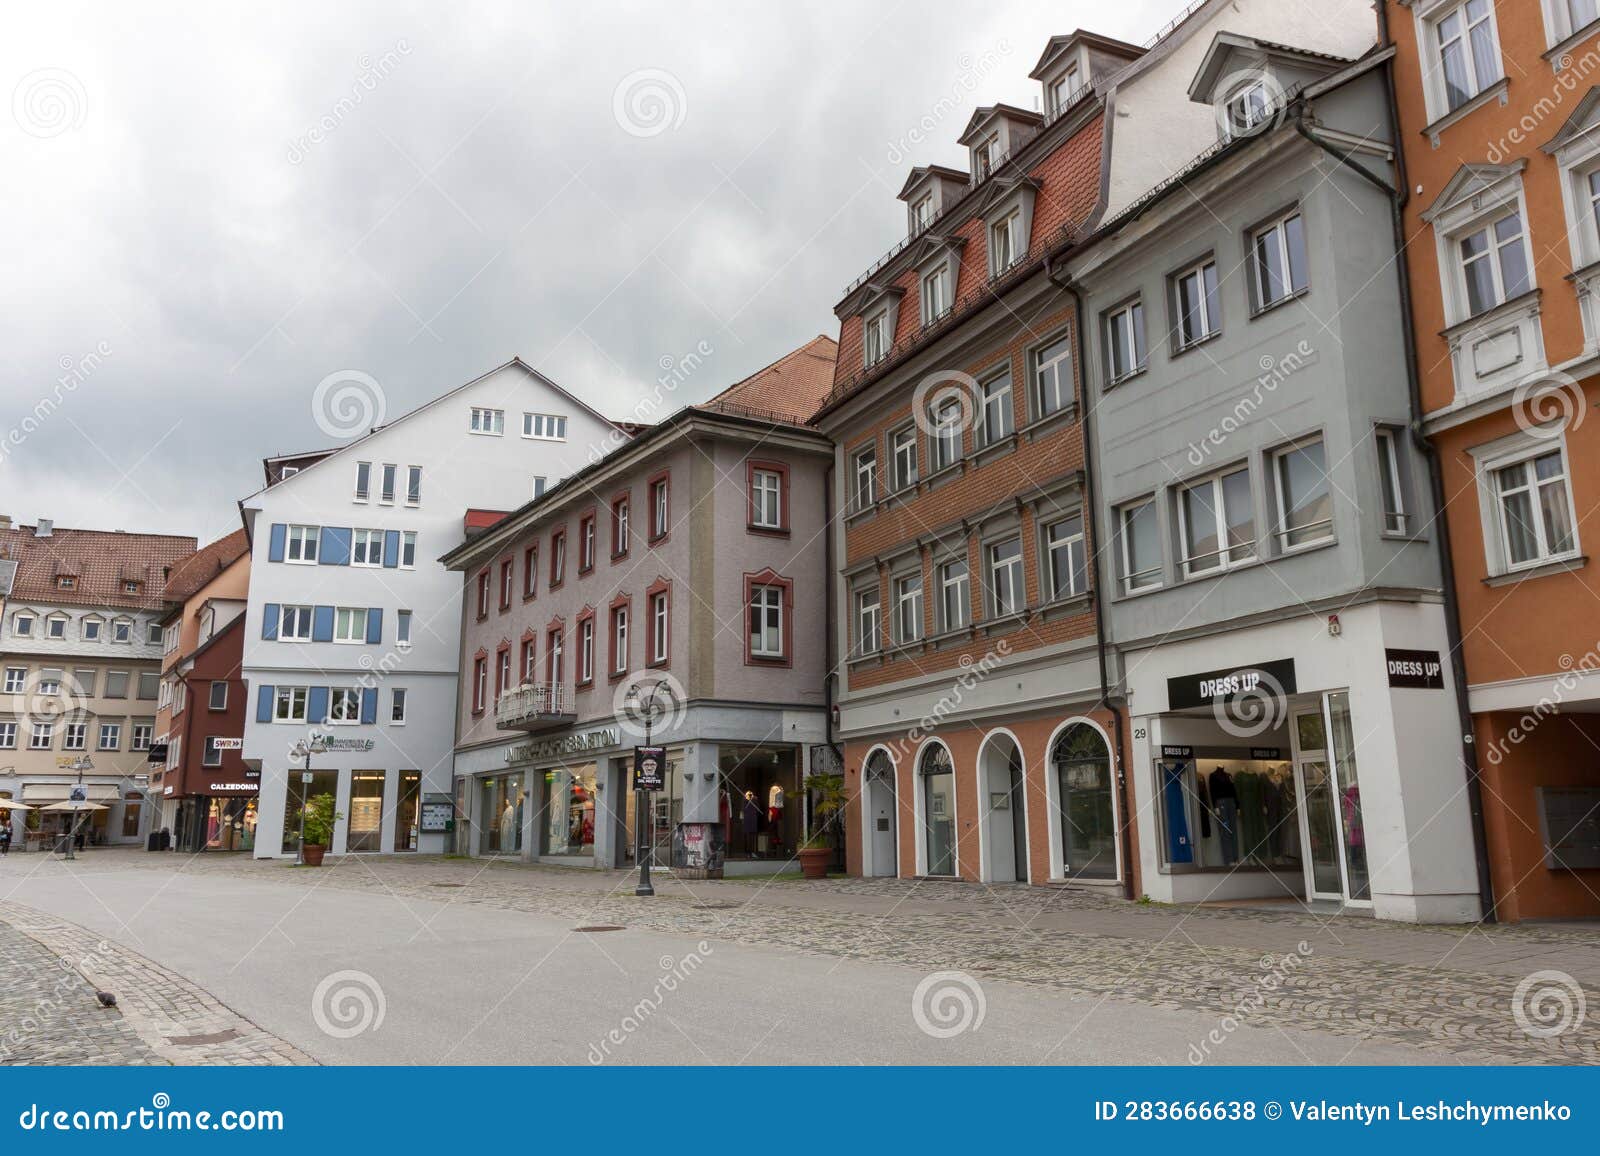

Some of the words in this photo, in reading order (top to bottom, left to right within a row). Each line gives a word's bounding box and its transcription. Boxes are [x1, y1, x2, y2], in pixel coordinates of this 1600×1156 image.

[1388, 661, 1423, 676] DRESS
[1424, 662, 1440, 677] UP
[1200, 676, 1240, 698] DRESS
[1242, 672, 1260, 692] UP
[1134, 729, 1146, 739] 29
[215, 740, 232, 748] SWR
[1164, 746, 1182, 755] DRESS
[1182, 747, 1190, 756] UP
